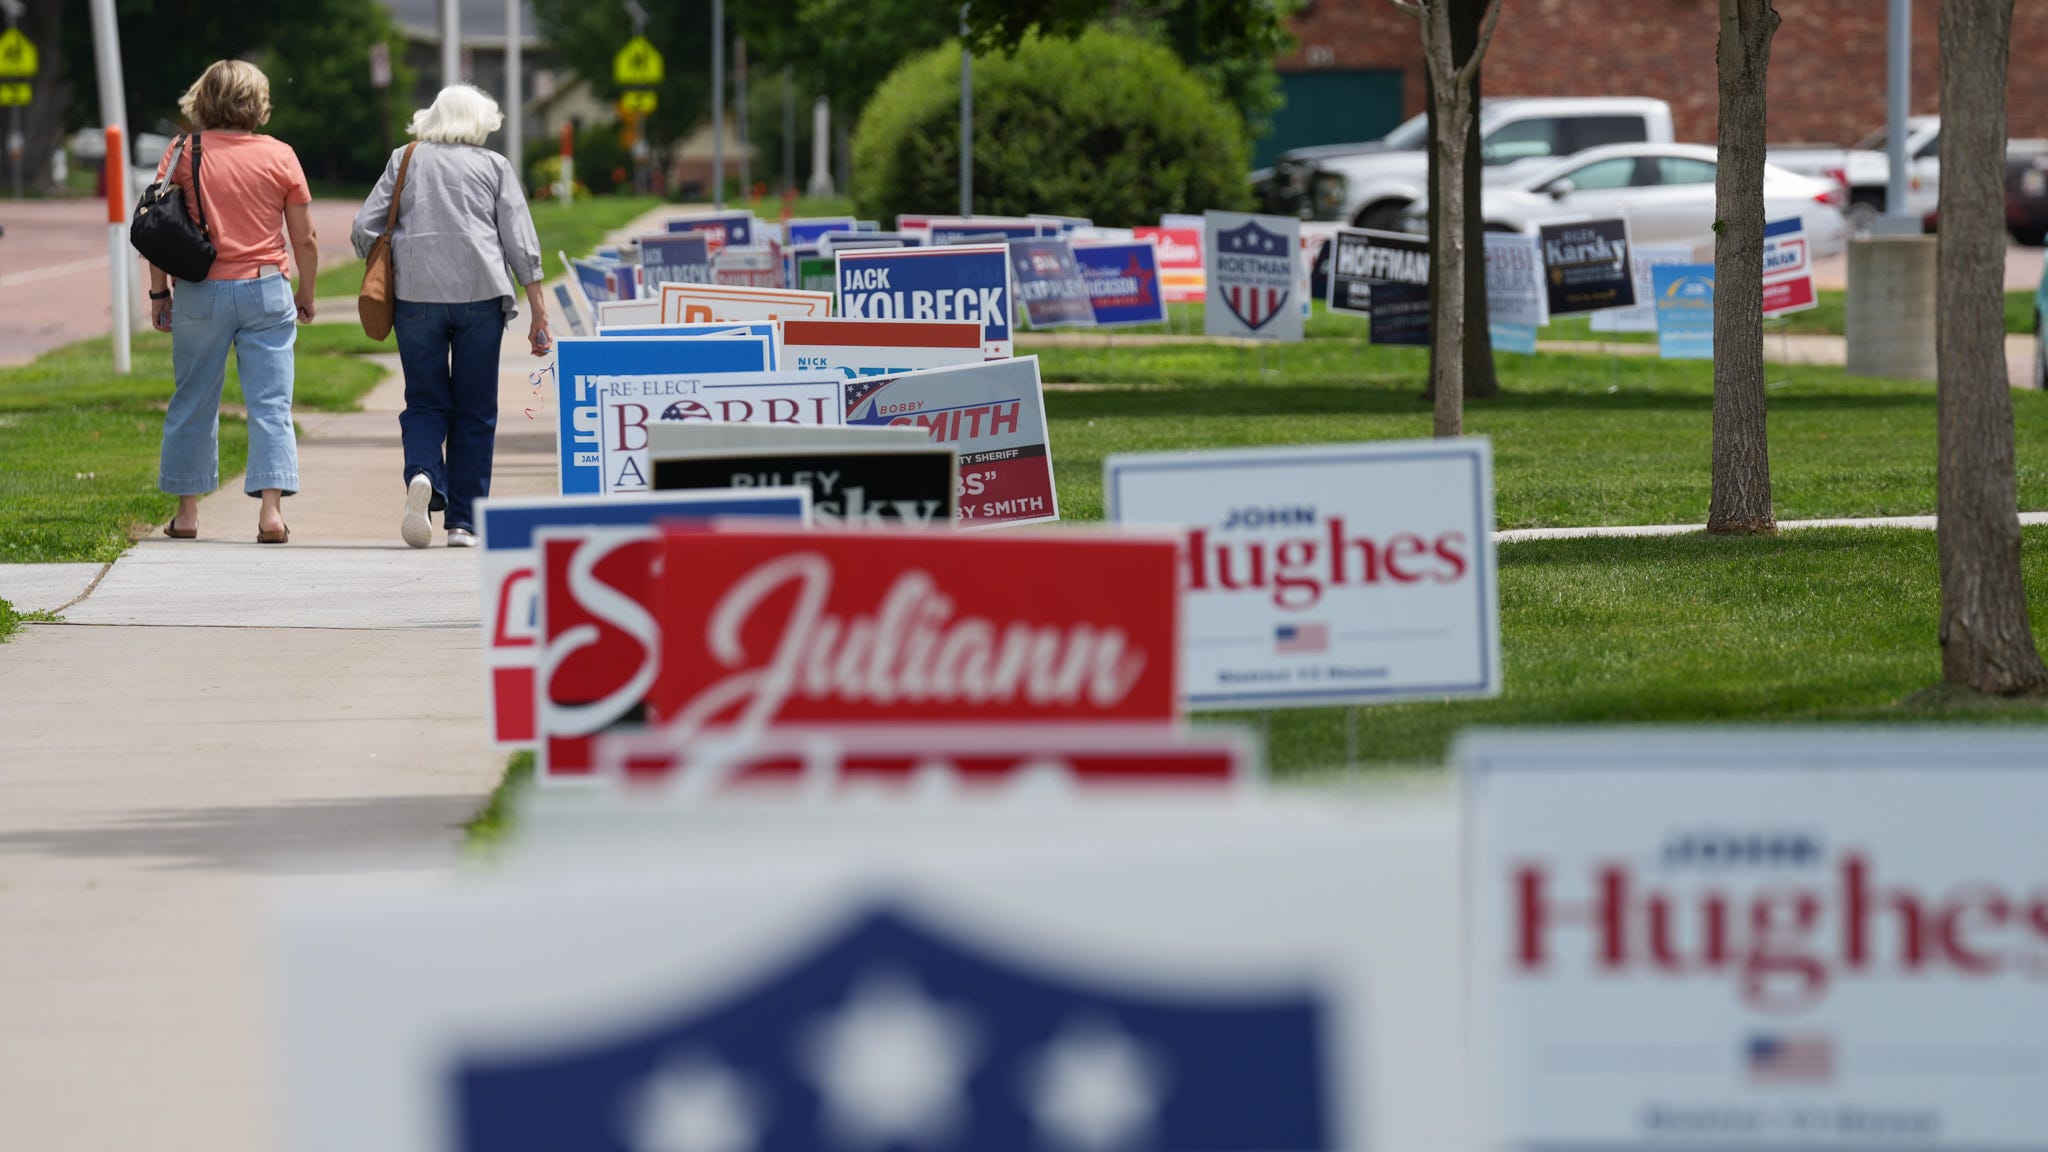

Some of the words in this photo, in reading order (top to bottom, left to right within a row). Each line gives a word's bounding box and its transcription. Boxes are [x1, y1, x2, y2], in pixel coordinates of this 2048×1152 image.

[1337, 243, 1430, 285] HOFFMAN
[1545, 235, 1626, 270] Karsky
[1217, 256, 1291, 276] ROETMAN
[844, 267, 891, 291] JACK
[844, 287, 1005, 326] KOLBECK
[798, 358, 827, 366] NICK
[642, 379, 701, 396] ELECT
[879, 401, 925, 415] BOBBY
[888, 402, 1020, 443] MITH
[974, 449, 1019, 463] SHERIFF
[812, 486, 943, 529] sky
[982, 495, 1043, 517] SMITH
[1222, 505, 1318, 531] JOHN
[676, 551, 1147, 734] Juliann
